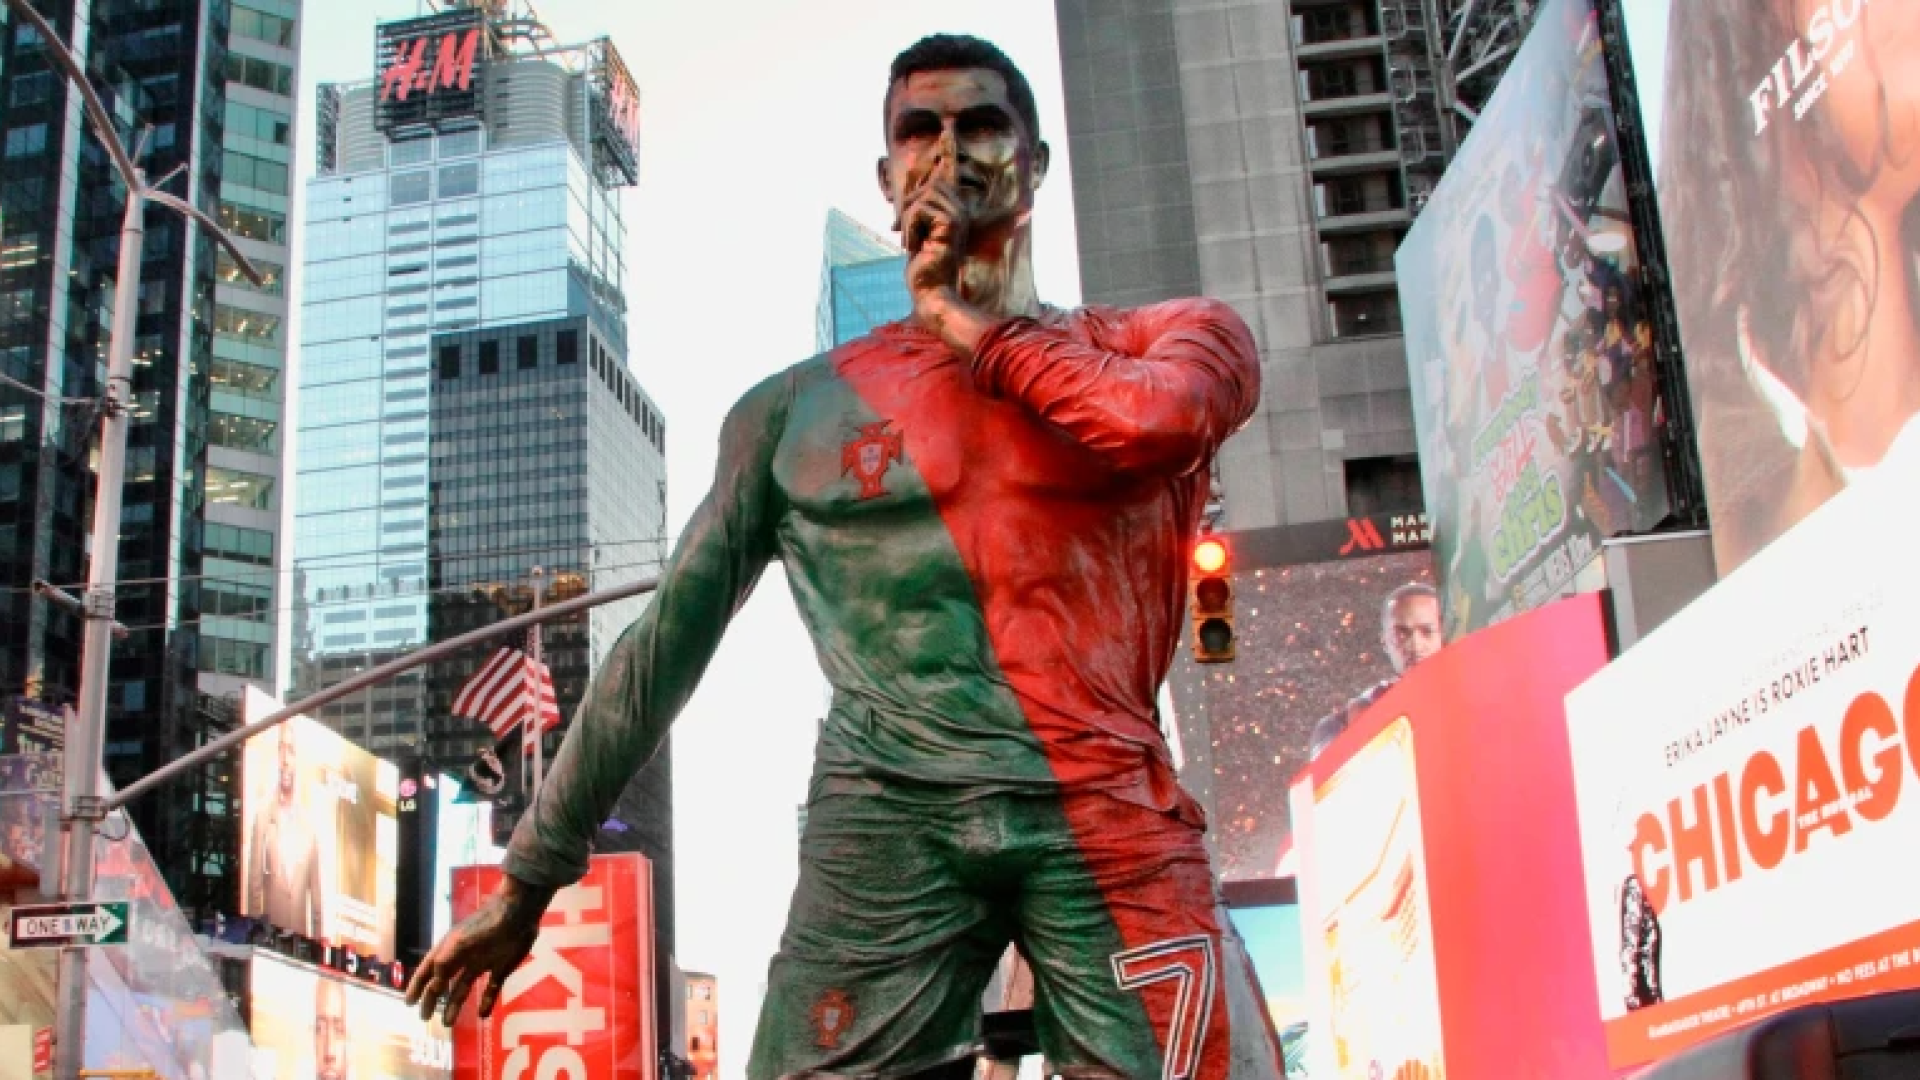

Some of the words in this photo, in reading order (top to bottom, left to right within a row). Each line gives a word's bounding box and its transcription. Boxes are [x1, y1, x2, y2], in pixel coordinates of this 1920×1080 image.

[380, 28, 481, 101] H&M
[1665, 728, 1704, 768] ERIKA
[1707, 697, 1751, 745] JAYNE
[1754, 687, 1768, 714] IS
[1771, 656, 1821, 704] ROXIE
[1823, 624, 1869, 674] HART
[400, 799, 416, 812] LG
[27, 917, 58, 935] ONE
[77, 915, 110, 933] WAY
[1111, 936, 1215, 1080] 7
